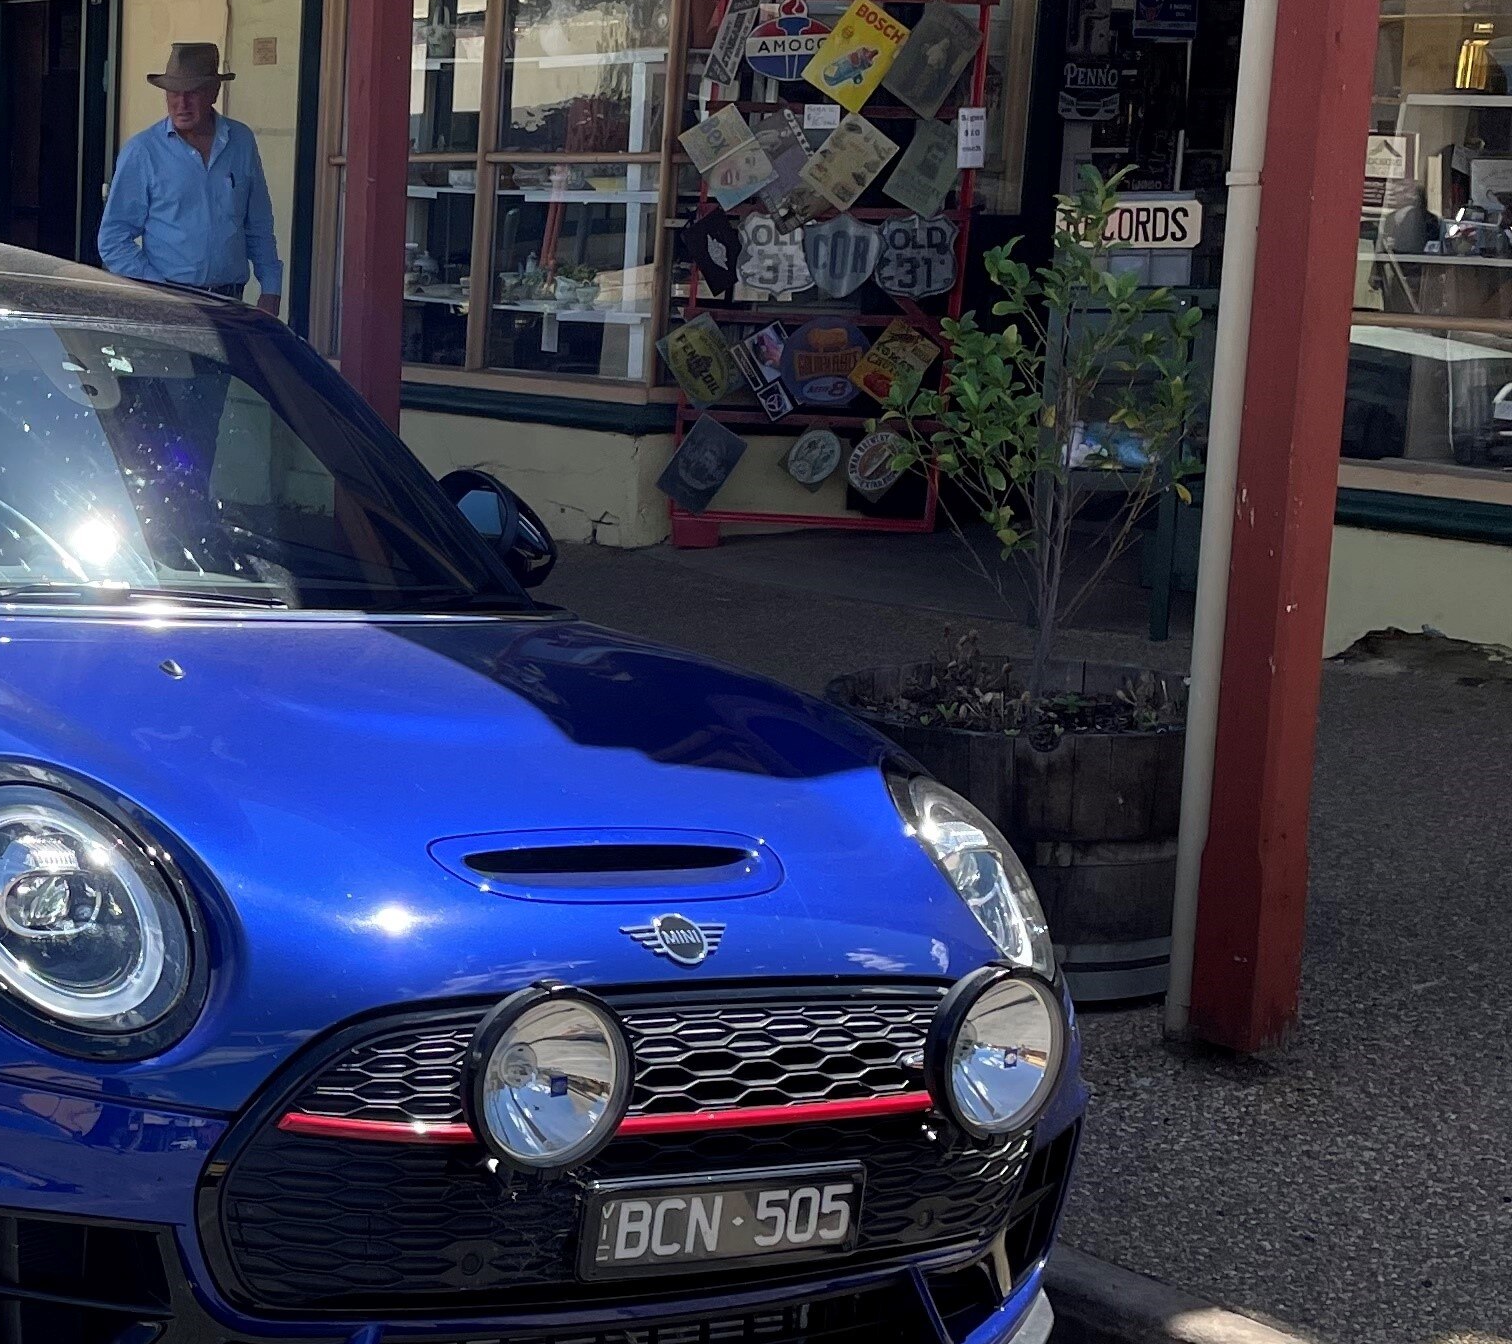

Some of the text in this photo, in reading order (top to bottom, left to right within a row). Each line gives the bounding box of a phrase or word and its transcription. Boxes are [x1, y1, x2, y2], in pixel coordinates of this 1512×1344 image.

[854, 3, 906, 44] BOSCH
[889, 226, 947, 251] OLD
[897, 256, 933, 289] 31
[661, 929, 701, 944] MINI
